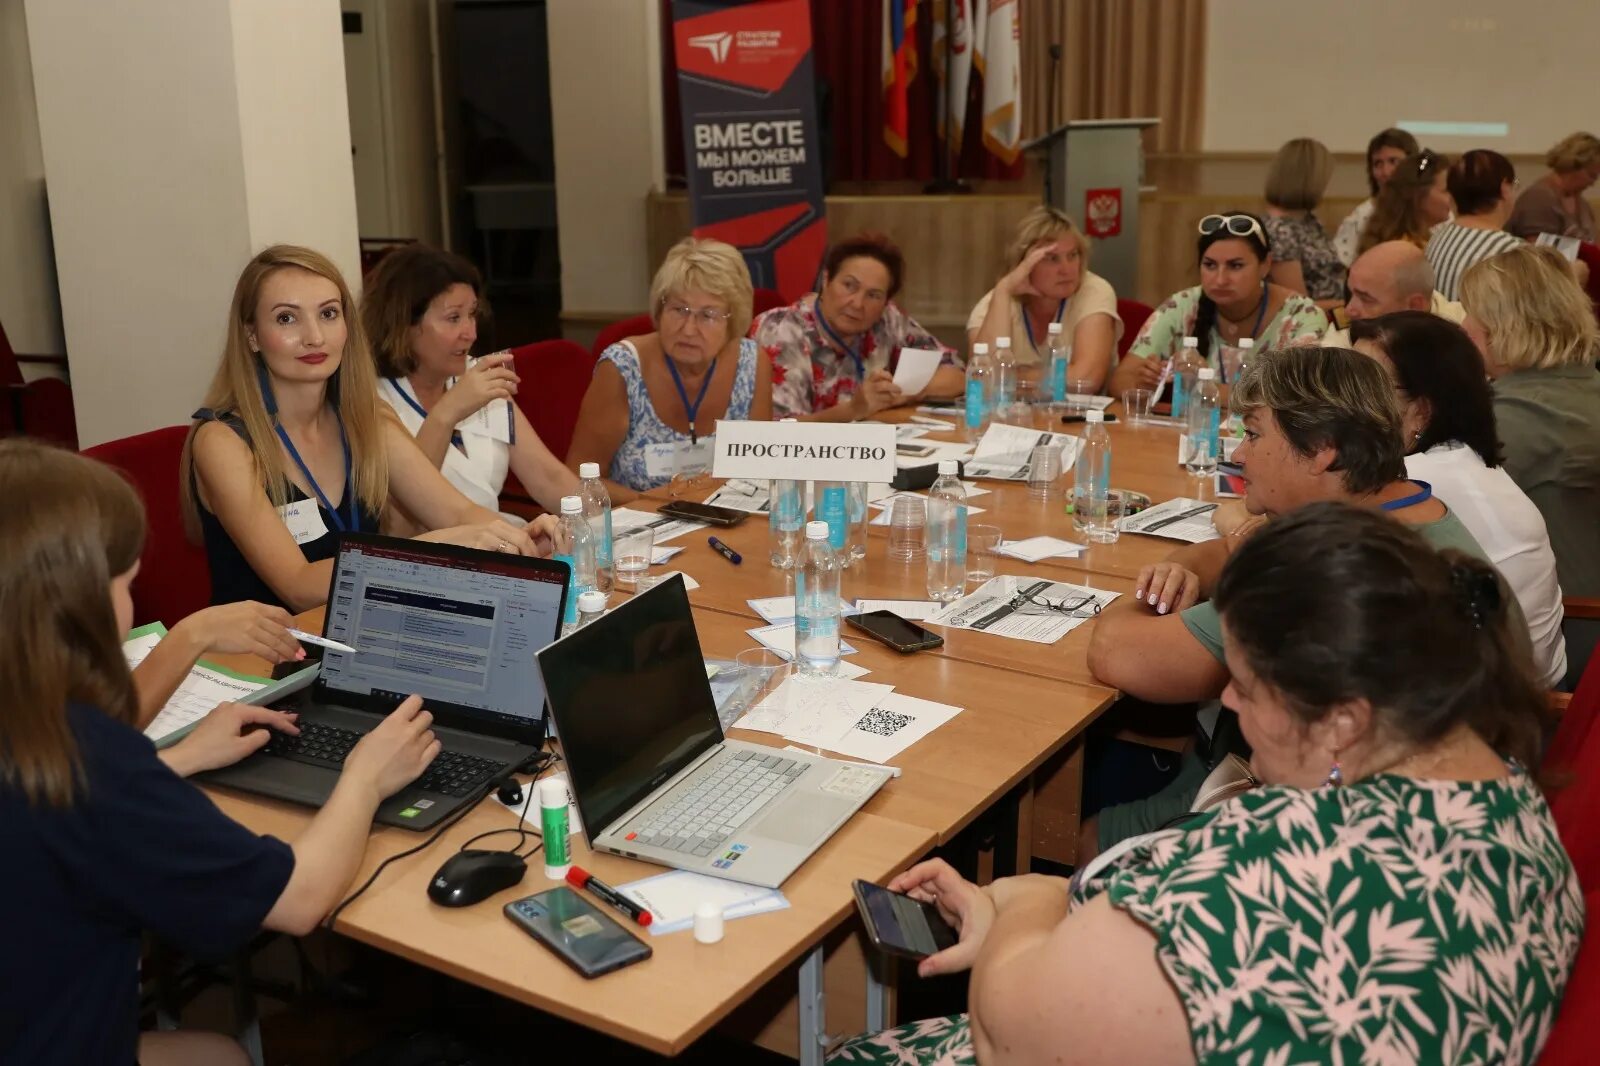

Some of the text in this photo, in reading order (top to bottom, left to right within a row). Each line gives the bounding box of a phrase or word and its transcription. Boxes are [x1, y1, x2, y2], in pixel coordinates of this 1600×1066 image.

[695, 121, 804, 148] ВМЕСТЕ
[697, 147, 806, 168] МЫ МОЖЕМ
[712, 167, 792, 187] БОЛЬШЕ
[727, 443, 886, 460] ПРОСТРАНСТВО
